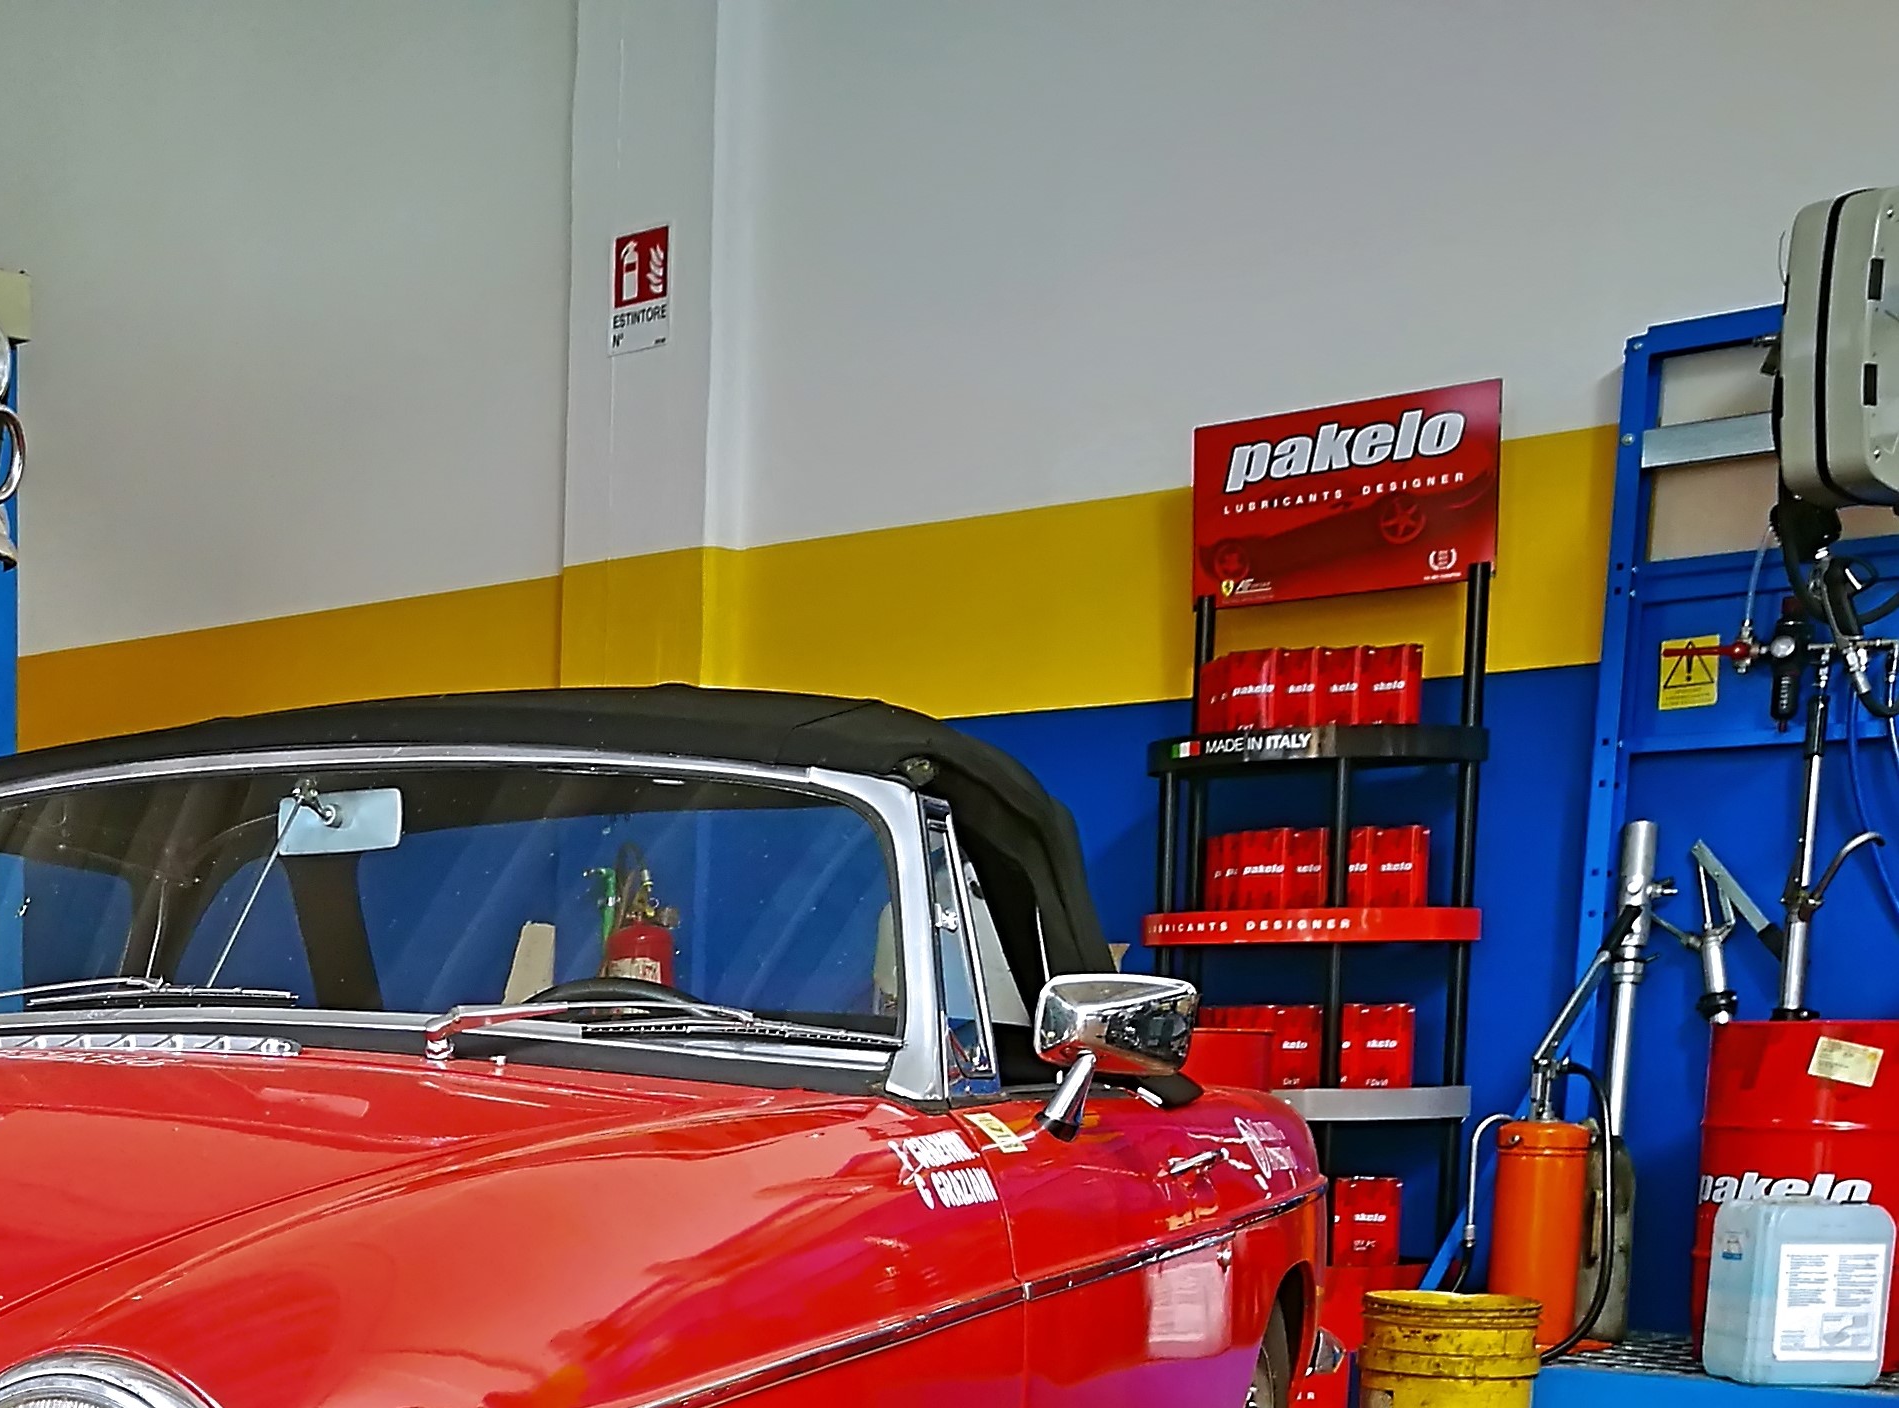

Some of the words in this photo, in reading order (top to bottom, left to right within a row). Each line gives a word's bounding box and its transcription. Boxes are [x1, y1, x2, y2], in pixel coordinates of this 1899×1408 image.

[612, 303, 667, 329] ESTINTORE
[1224, 408, 1467, 493] pakelo
[1223, 488, 1343, 515] LUBRICANTS
[1362, 471, 1465, 496] DESIGNER
[1205, 736, 1245, 754] MADE
[1247, 734, 1263, 751] IN
[1265, 732, 1312, 751] ITALY
[1148, 920, 1229, 934] UBRICANTS
[1245, 917, 1351, 932] DESIGNER
[931, 1167, 998, 1208] GRAZIANI
